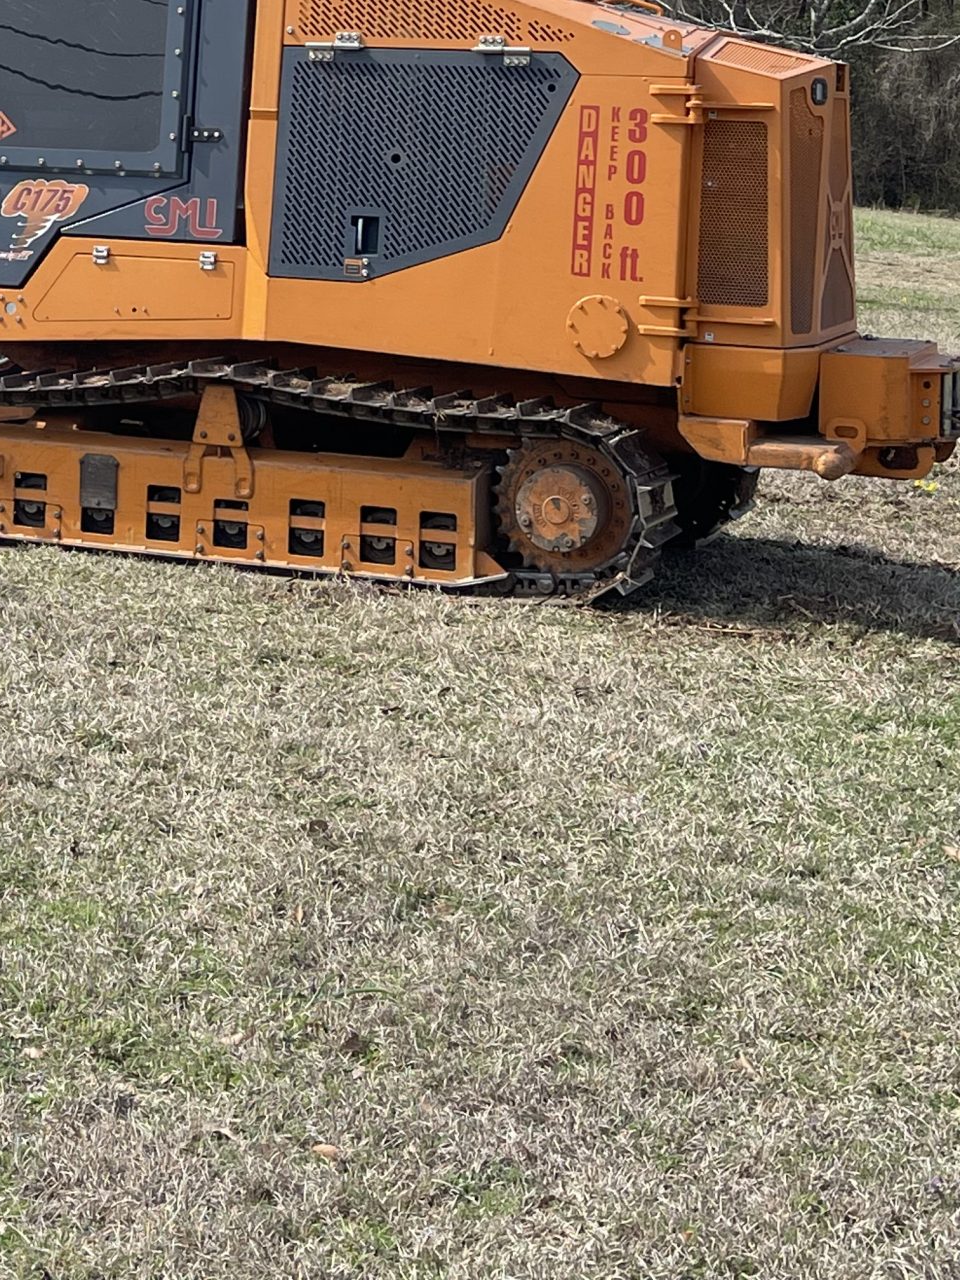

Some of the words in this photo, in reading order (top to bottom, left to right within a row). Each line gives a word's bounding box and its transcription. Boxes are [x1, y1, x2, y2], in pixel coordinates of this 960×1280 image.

[607, 106, 621, 182] KEEP
[623, 108, 648, 226] 300
[12, 187, 75, 213] C175
[144, 195, 223, 239] CMI
[573, 107, 599, 276] DANGER
[601, 204, 615, 280] BACK
